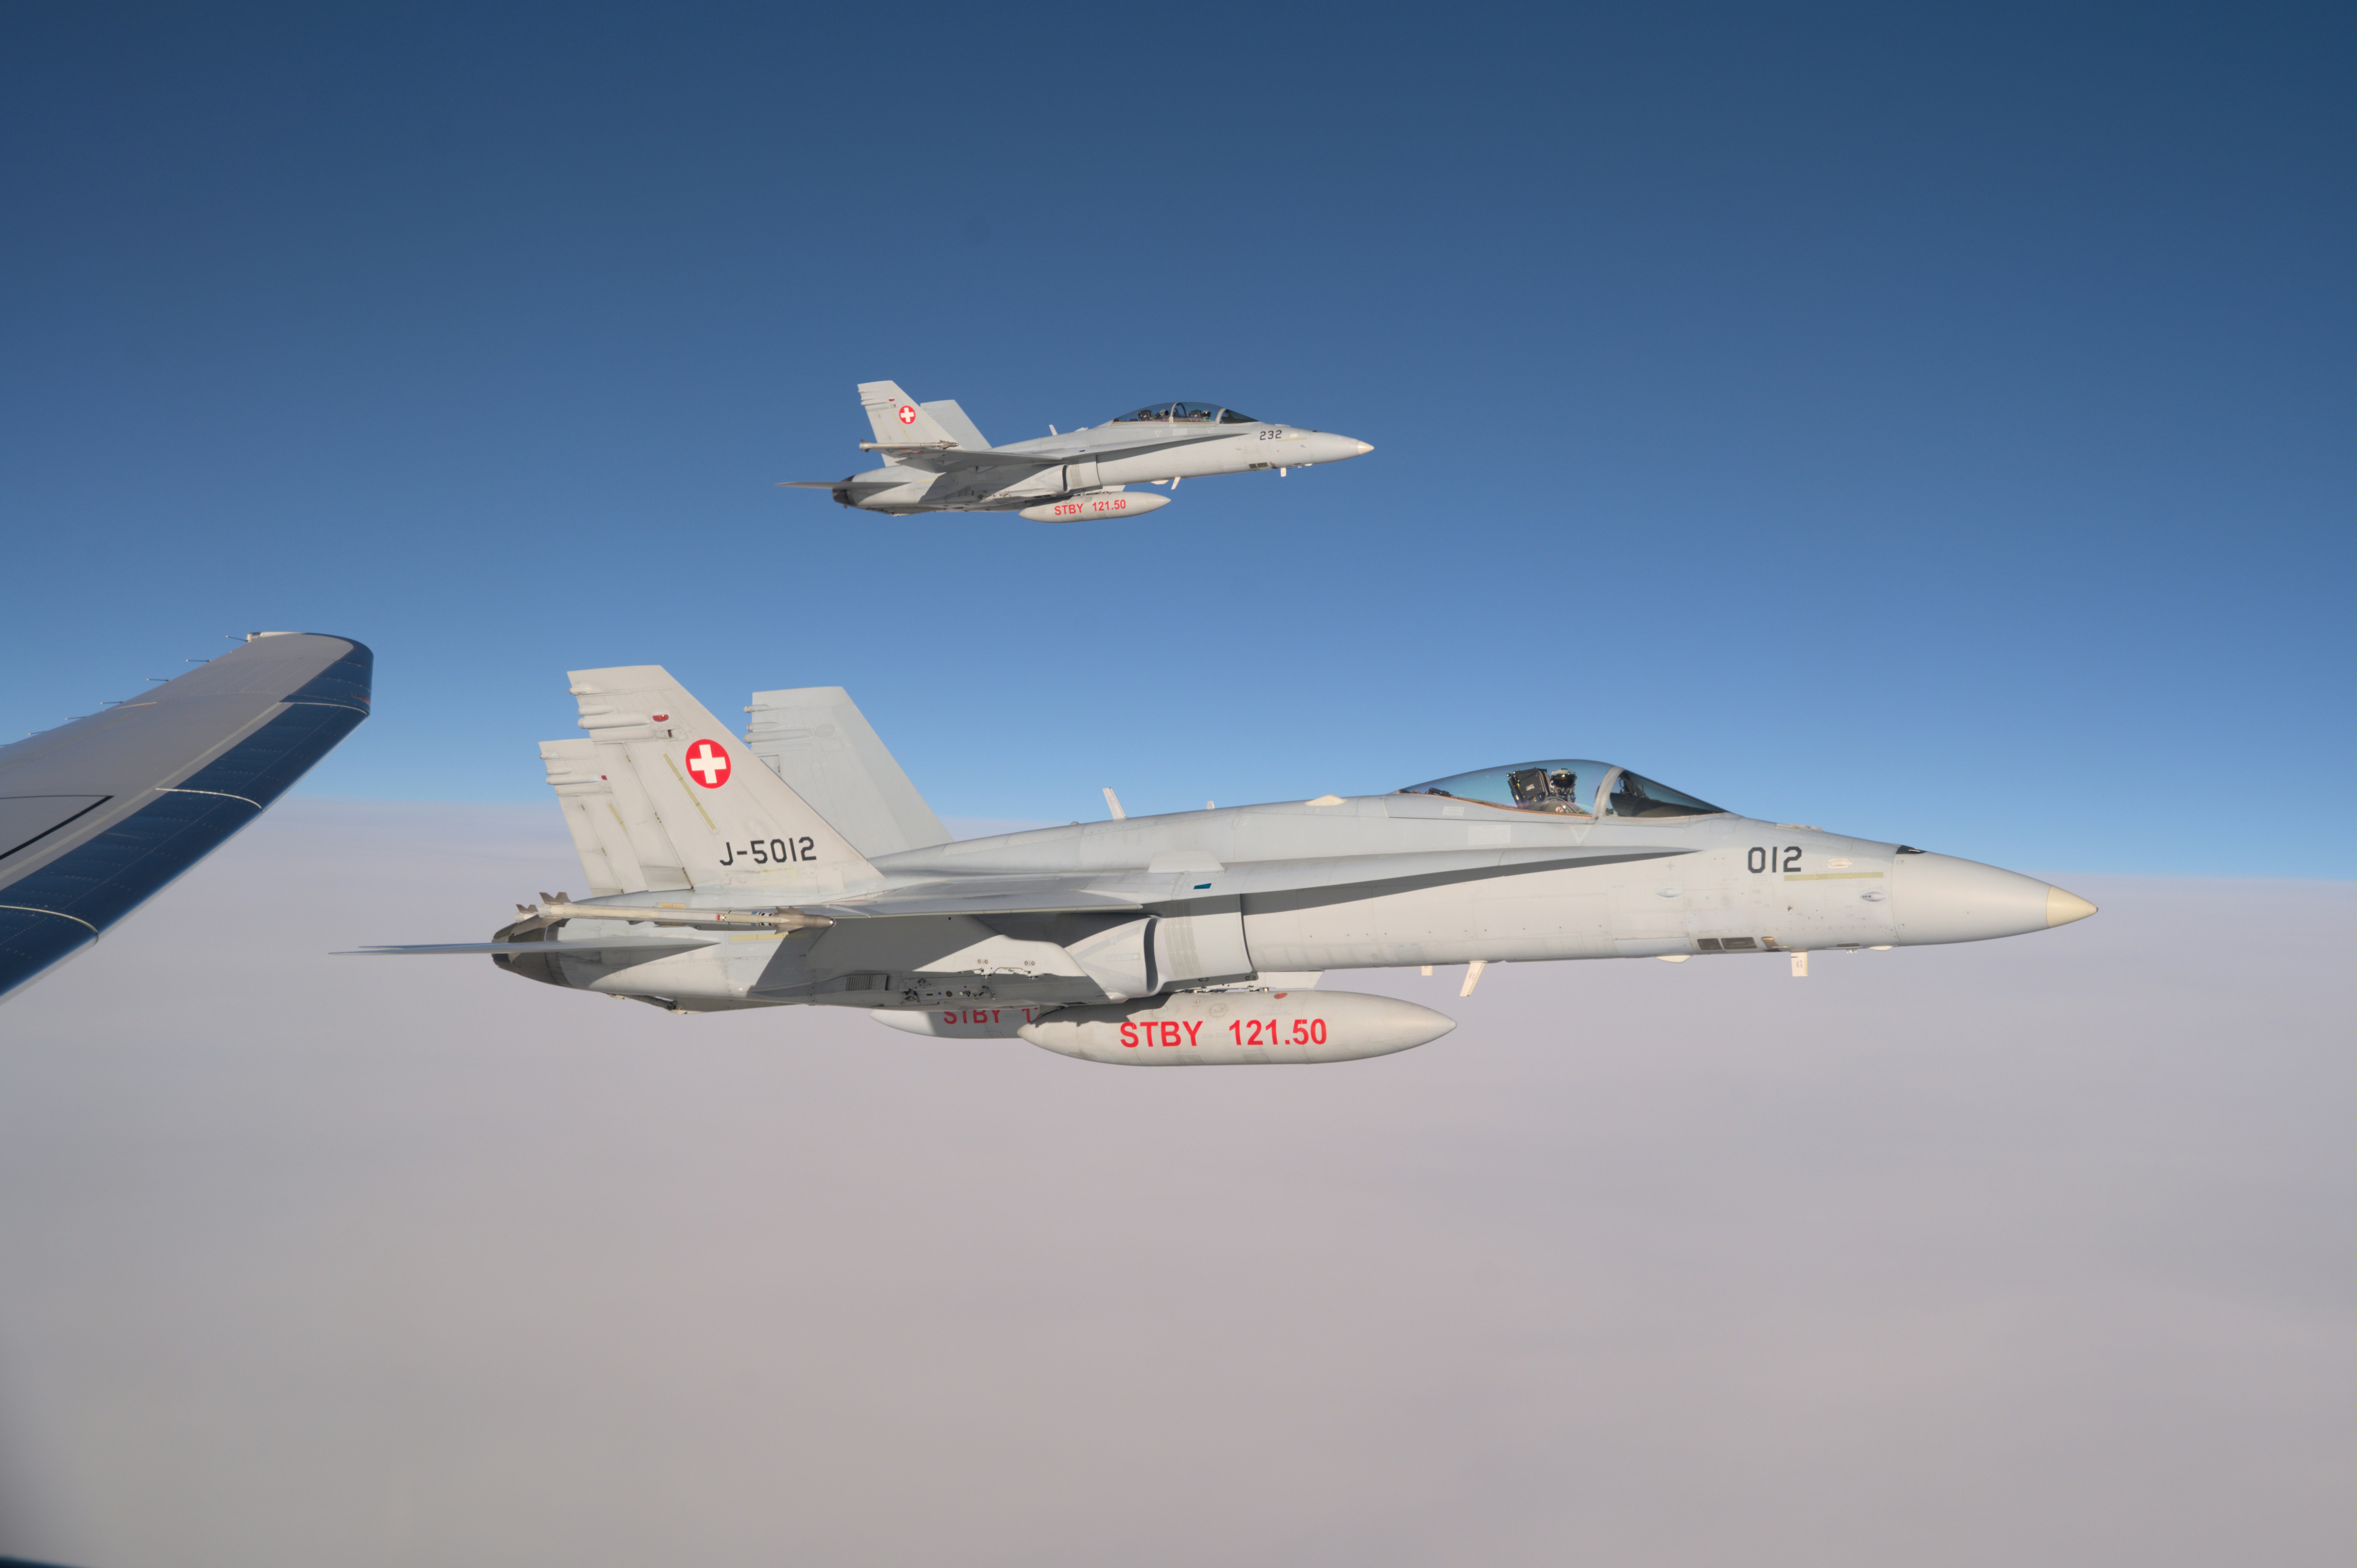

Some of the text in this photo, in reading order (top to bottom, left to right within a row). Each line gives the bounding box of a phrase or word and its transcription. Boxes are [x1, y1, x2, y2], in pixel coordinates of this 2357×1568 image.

[1260, 429, 1282, 440] 232
[1054, 499, 1126, 516] STBY 121.50
[719, 836, 817, 866] J-5012
[1748, 846, 1802, 874] 012
[1109, 937, 1117, 945] JET
[1106, 954, 1133, 962] DANGER
[1110, 971, 1132, 981] INTAKE
[1119, 1017, 1328, 1049] STBY 121.50
